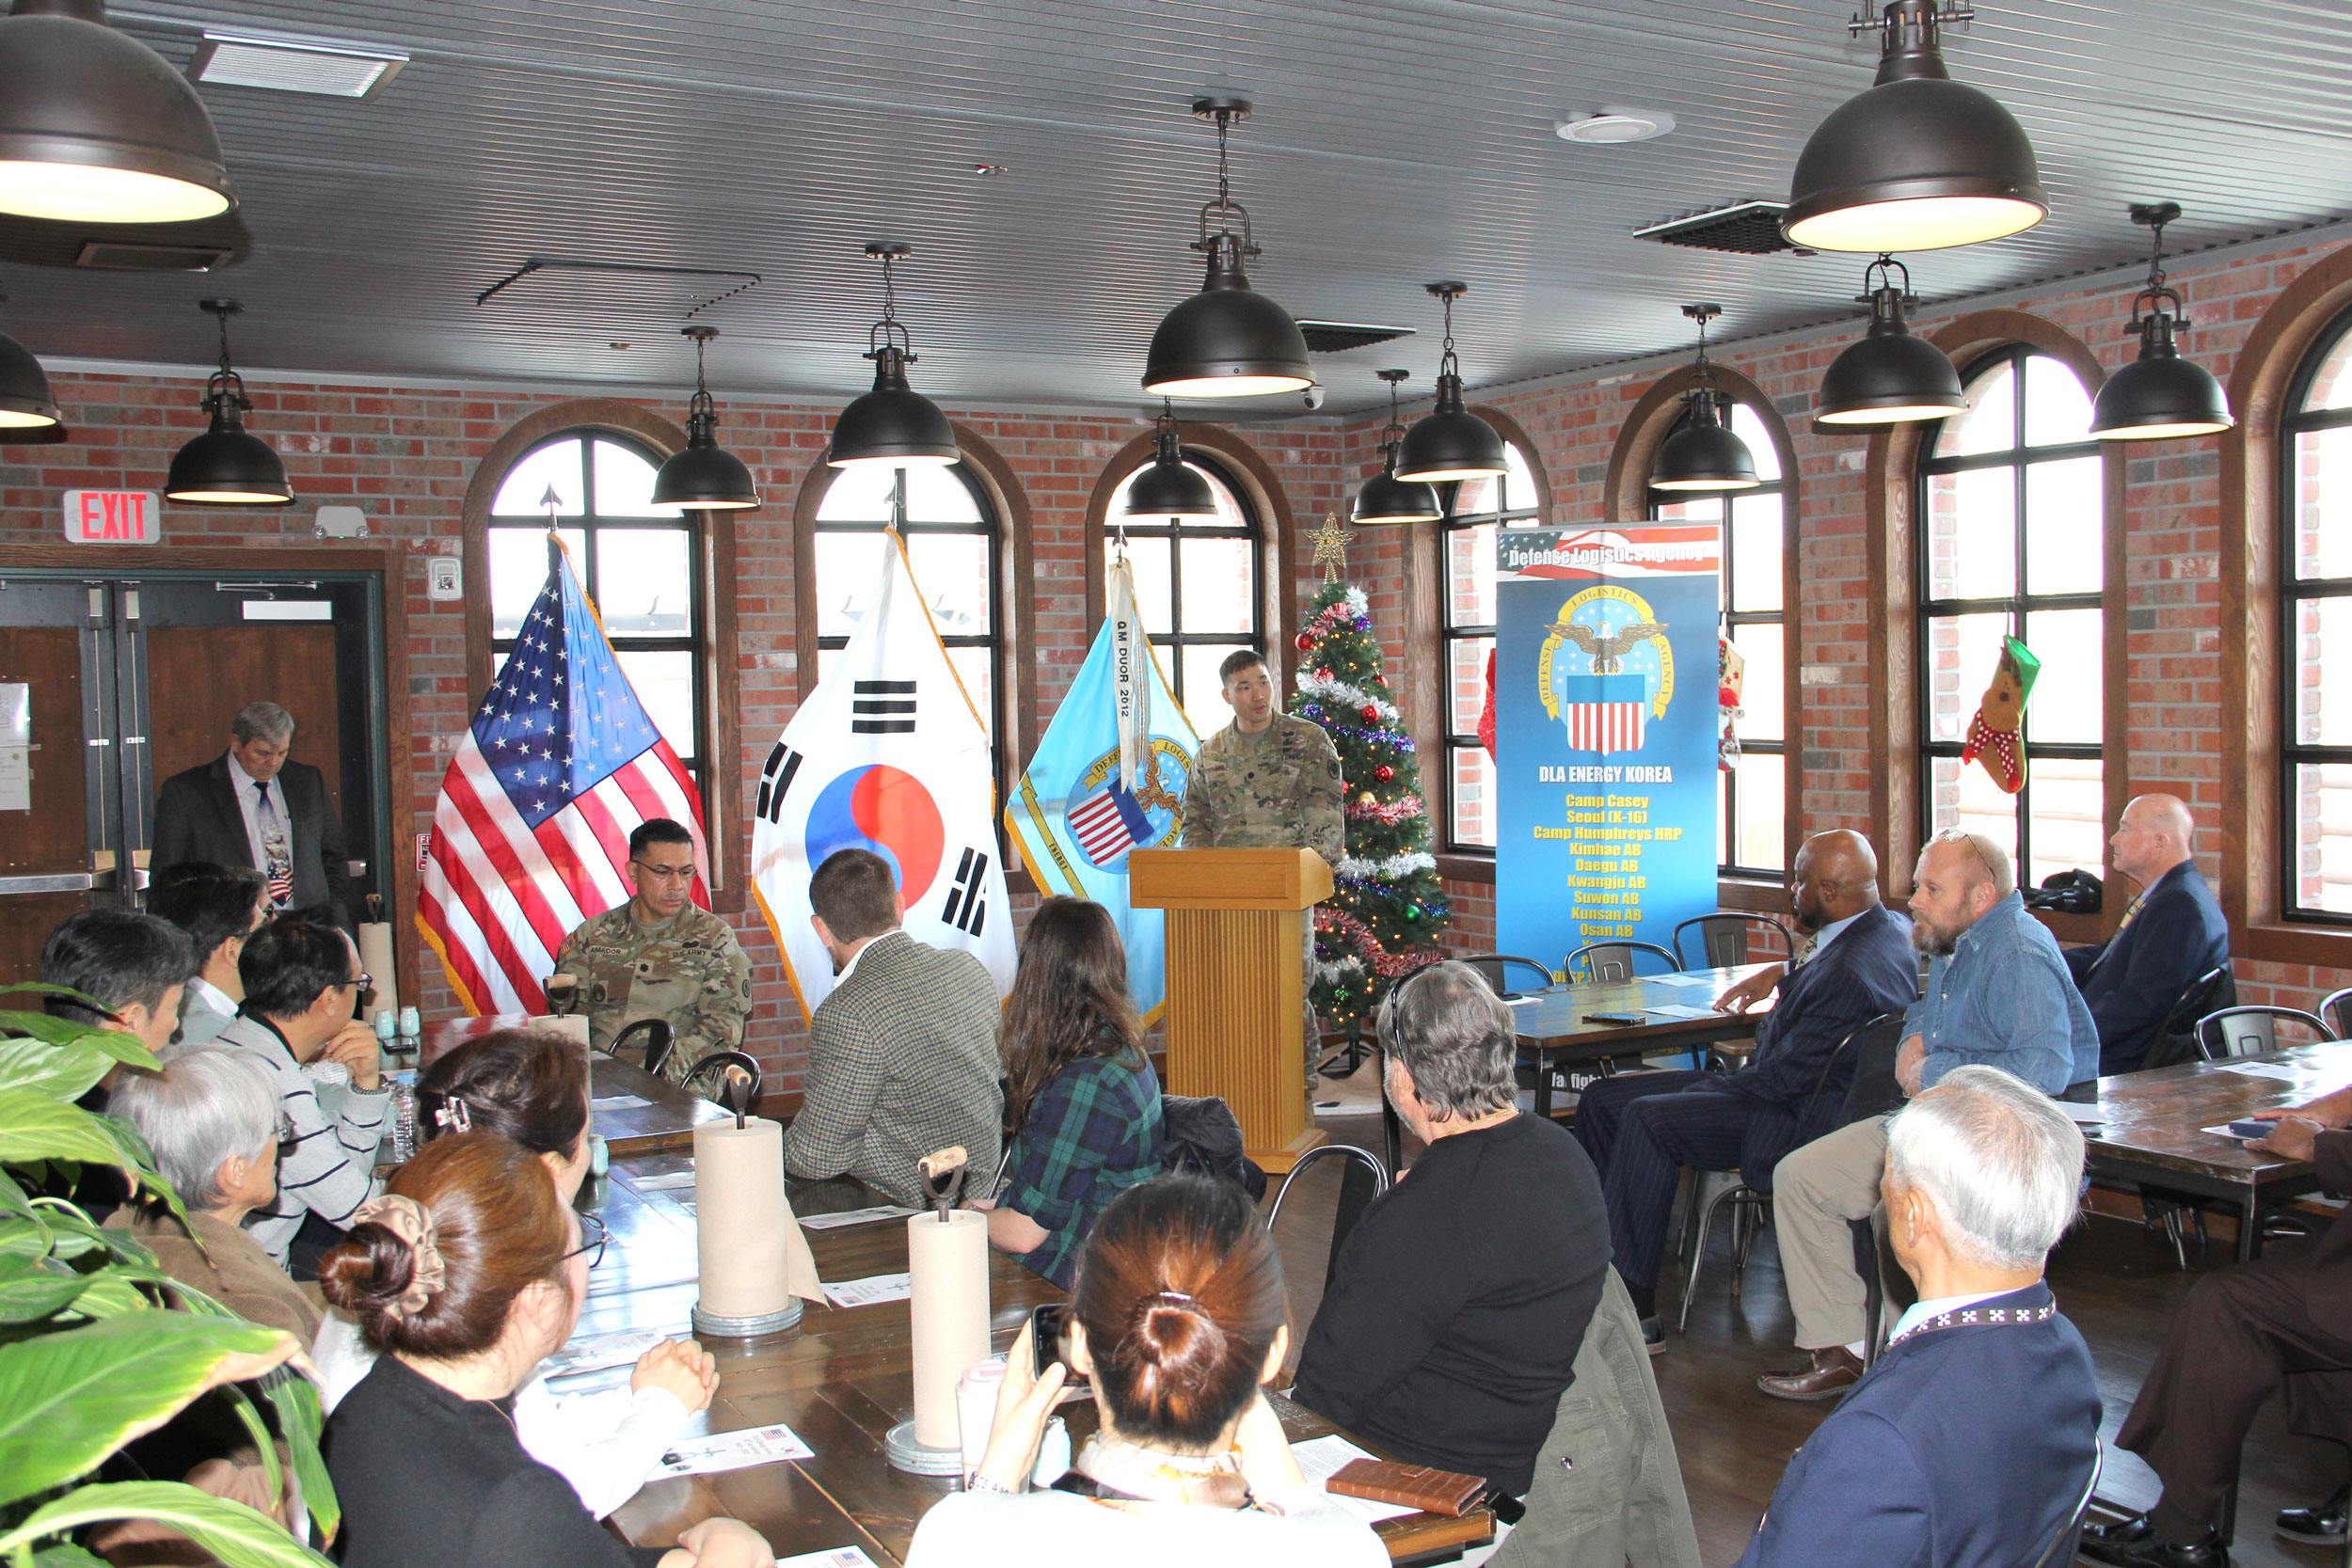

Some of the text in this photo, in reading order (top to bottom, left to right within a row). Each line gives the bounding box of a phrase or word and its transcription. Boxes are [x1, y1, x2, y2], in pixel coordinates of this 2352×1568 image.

[80, 492, 148, 540] EXIT
[1509, 546, 1707, 565] Defense Logistics Agency
[1572, 587, 1638, 607] LOGISTICS
[1117, 621, 1129, 717] QM DUOR 2012
[1540, 642, 1552, 700] DEFENSE
[1660, 643, 1671, 697] AGENCY
[1539, 766, 1673, 783] DLA ENERGY KOREA
[1565, 794, 1649, 809] Camp Casey
[1566, 811, 1605, 824] Seoul
[1534, 826, 1682, 841] Camp Humphreys HRP
[1049, 843, 1069, 870] ENERGY
[1569, 843, 1642, 856] Kimhae AB
[1575, 859, 1639, 874] Daegu AB
[1567, 875, 1646, 890] Kwangju AB
[1574, 891, 1640, 905] Suwon AB
[1571, 907, 1643, 921] Kunsan AB
[1580, 924, 1634, 938] Osan AB
[591, 946, 621, 955] AMADOR
